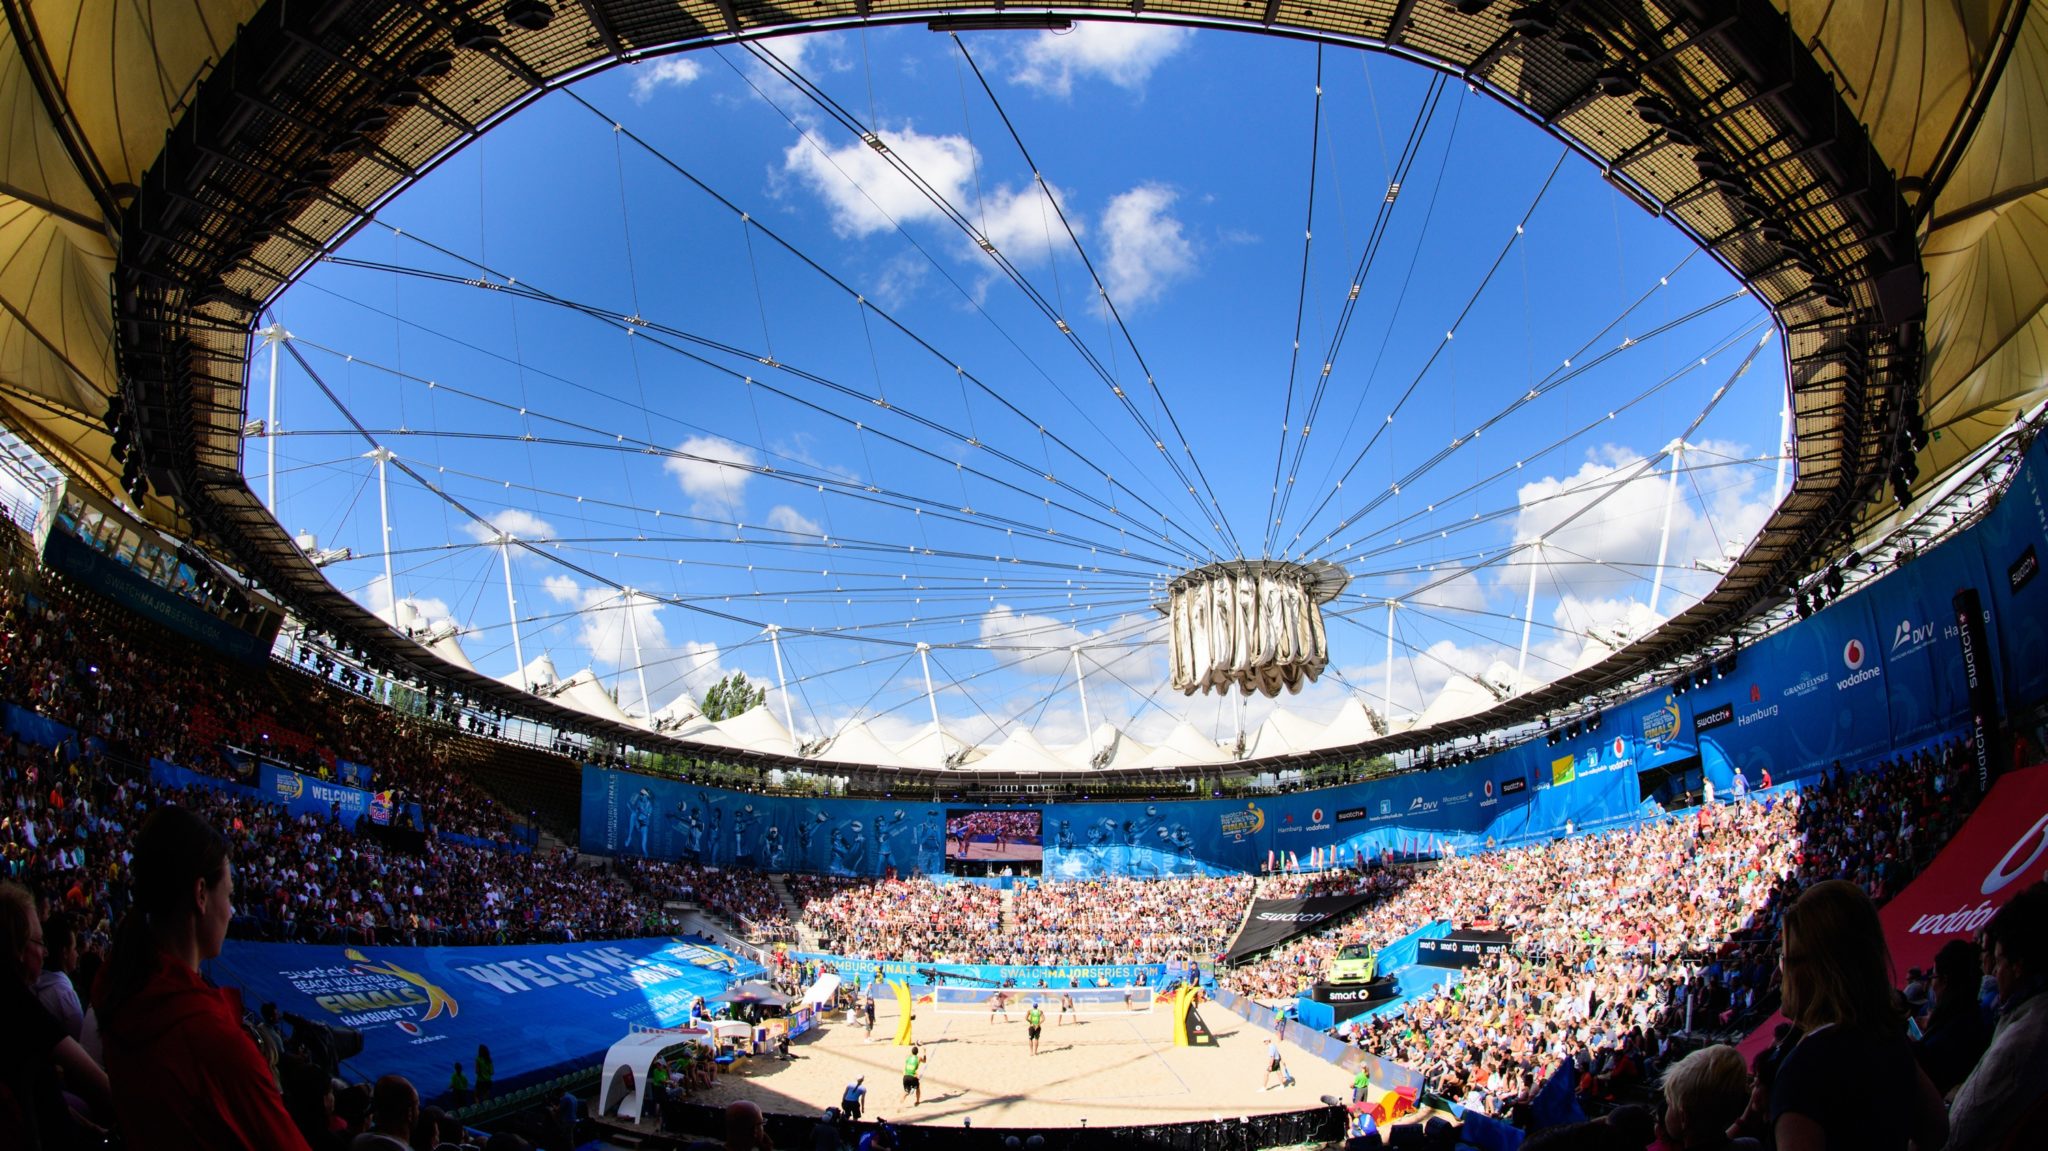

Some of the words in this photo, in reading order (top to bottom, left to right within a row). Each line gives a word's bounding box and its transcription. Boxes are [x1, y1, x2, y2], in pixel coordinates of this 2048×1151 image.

[2012, 556, 2034, 586] swatch
[104, 573, 221, 639] SWATCHMAJORSERIES.COM
[1912, 621, 1934, 645] DVV
[1959, 624, 1978, 689] swatch
[1836, 666, 1880, 691] vodafone
[1783, 682, 1806, 697] GRAND
[1696, 710, 1726, 728] swatch
[1738, 704, 1779, 727] Hamburg
[1644, 722, 1673, 739] FINALS
[1975, 726, 1988, 792] swatch
[312, 786, 361, 805] WELCOME
[1503, 782, 1520, 791] swatch
[1423, 801, 1438, 810] DVV
[1338, 811, 1360, 820] swatch
[1278, 825, 1303, 833] Hamburg
[1306, 823, 1330, 832] vodafone
[1256, 911, 1325, 922] swatch
[1908, 900, 2001, 934] vodafo
[1462, 944, 1475, 952] smart
[1486, 946, 1500, 954] smart
[456, 946, 649, 994] WELCOME
[1000, 966, 1158, 979] SWATCHMAJORSERIES.COM
[291, 978, 333, 991] BEACH
[332, 974, 397, 987] VOLLEYBALL
[574, 980, 617, 999] TO
[315, 988, 429, 1014] FINALS
[1329, 991, 1357, 1000] smart
[339, 1009, 402, 1027] HAMBURG
[400, 1006, 417, 1017] '17
